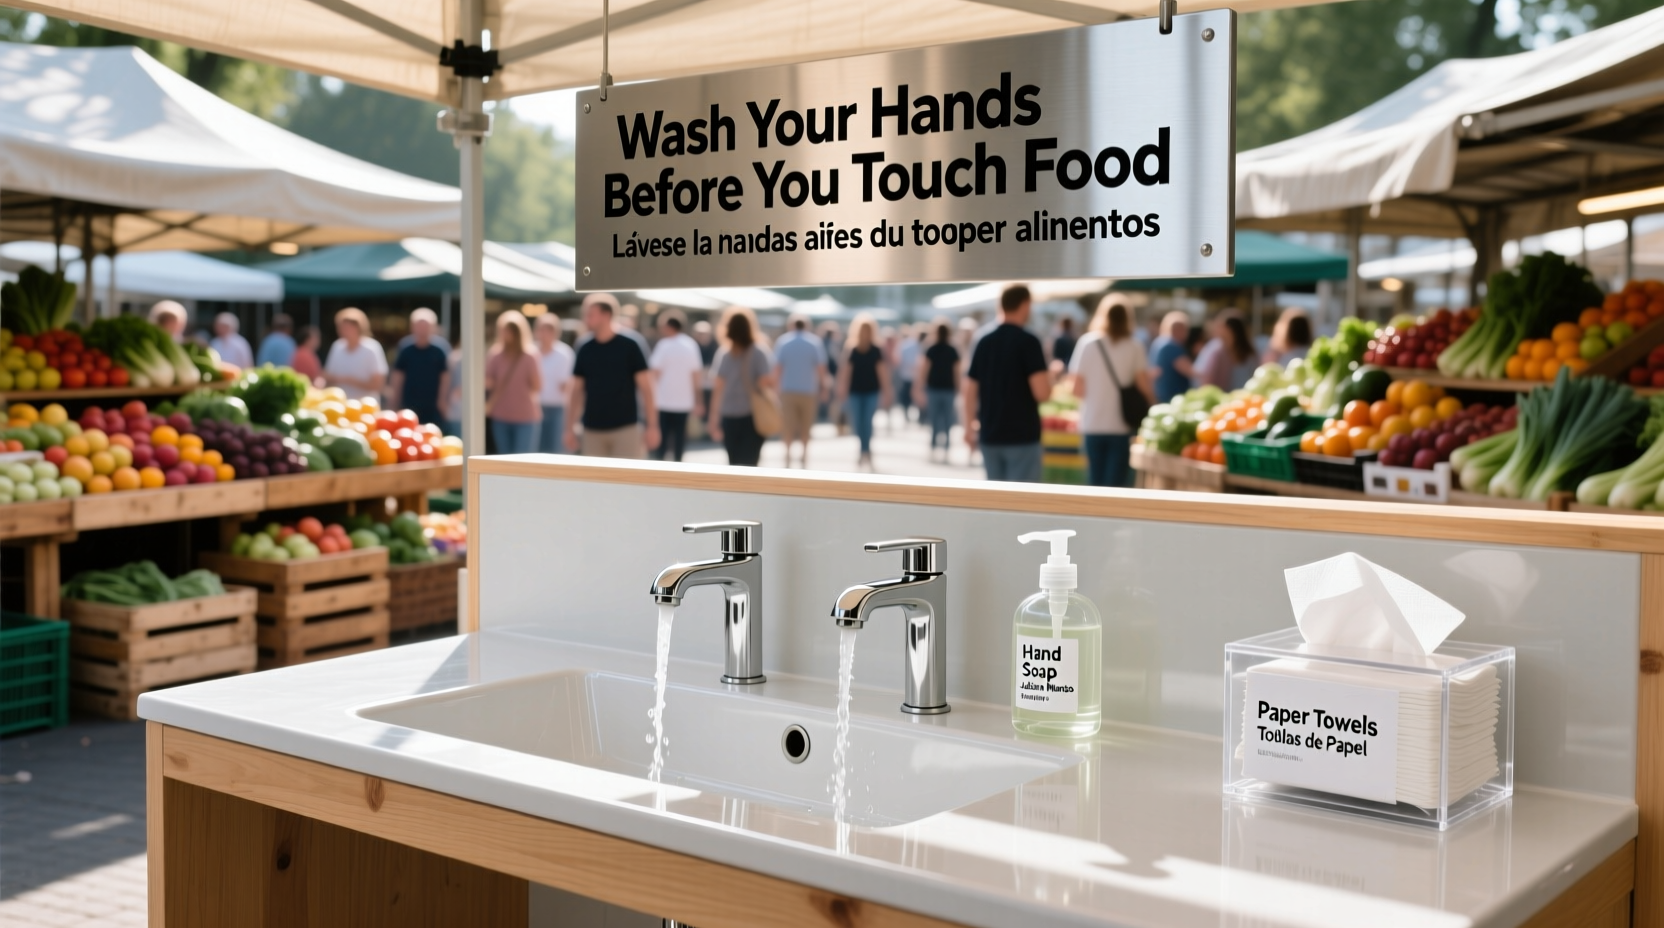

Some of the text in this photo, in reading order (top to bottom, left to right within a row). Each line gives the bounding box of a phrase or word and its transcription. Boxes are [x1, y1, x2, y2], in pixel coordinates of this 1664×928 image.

[617, 71, 1042, 161] Wash Your Hands
[604, 127, 1171, 219] Before You Touch Food
[612, 230, 687, 259] Lávese
[693, 229, 712, 256] la
[870, 218, 904, 248] du
[1015, 209, 1161, 244] alinentos
[1022, 643, 1062, 662] Hand
[1022, 661, 1058, 682] Soap
[1258, 700, 1379, 737] Paper Towels
[1304, 731, 1324, 750] de
[1326, 735, 1368, 758] Papel
